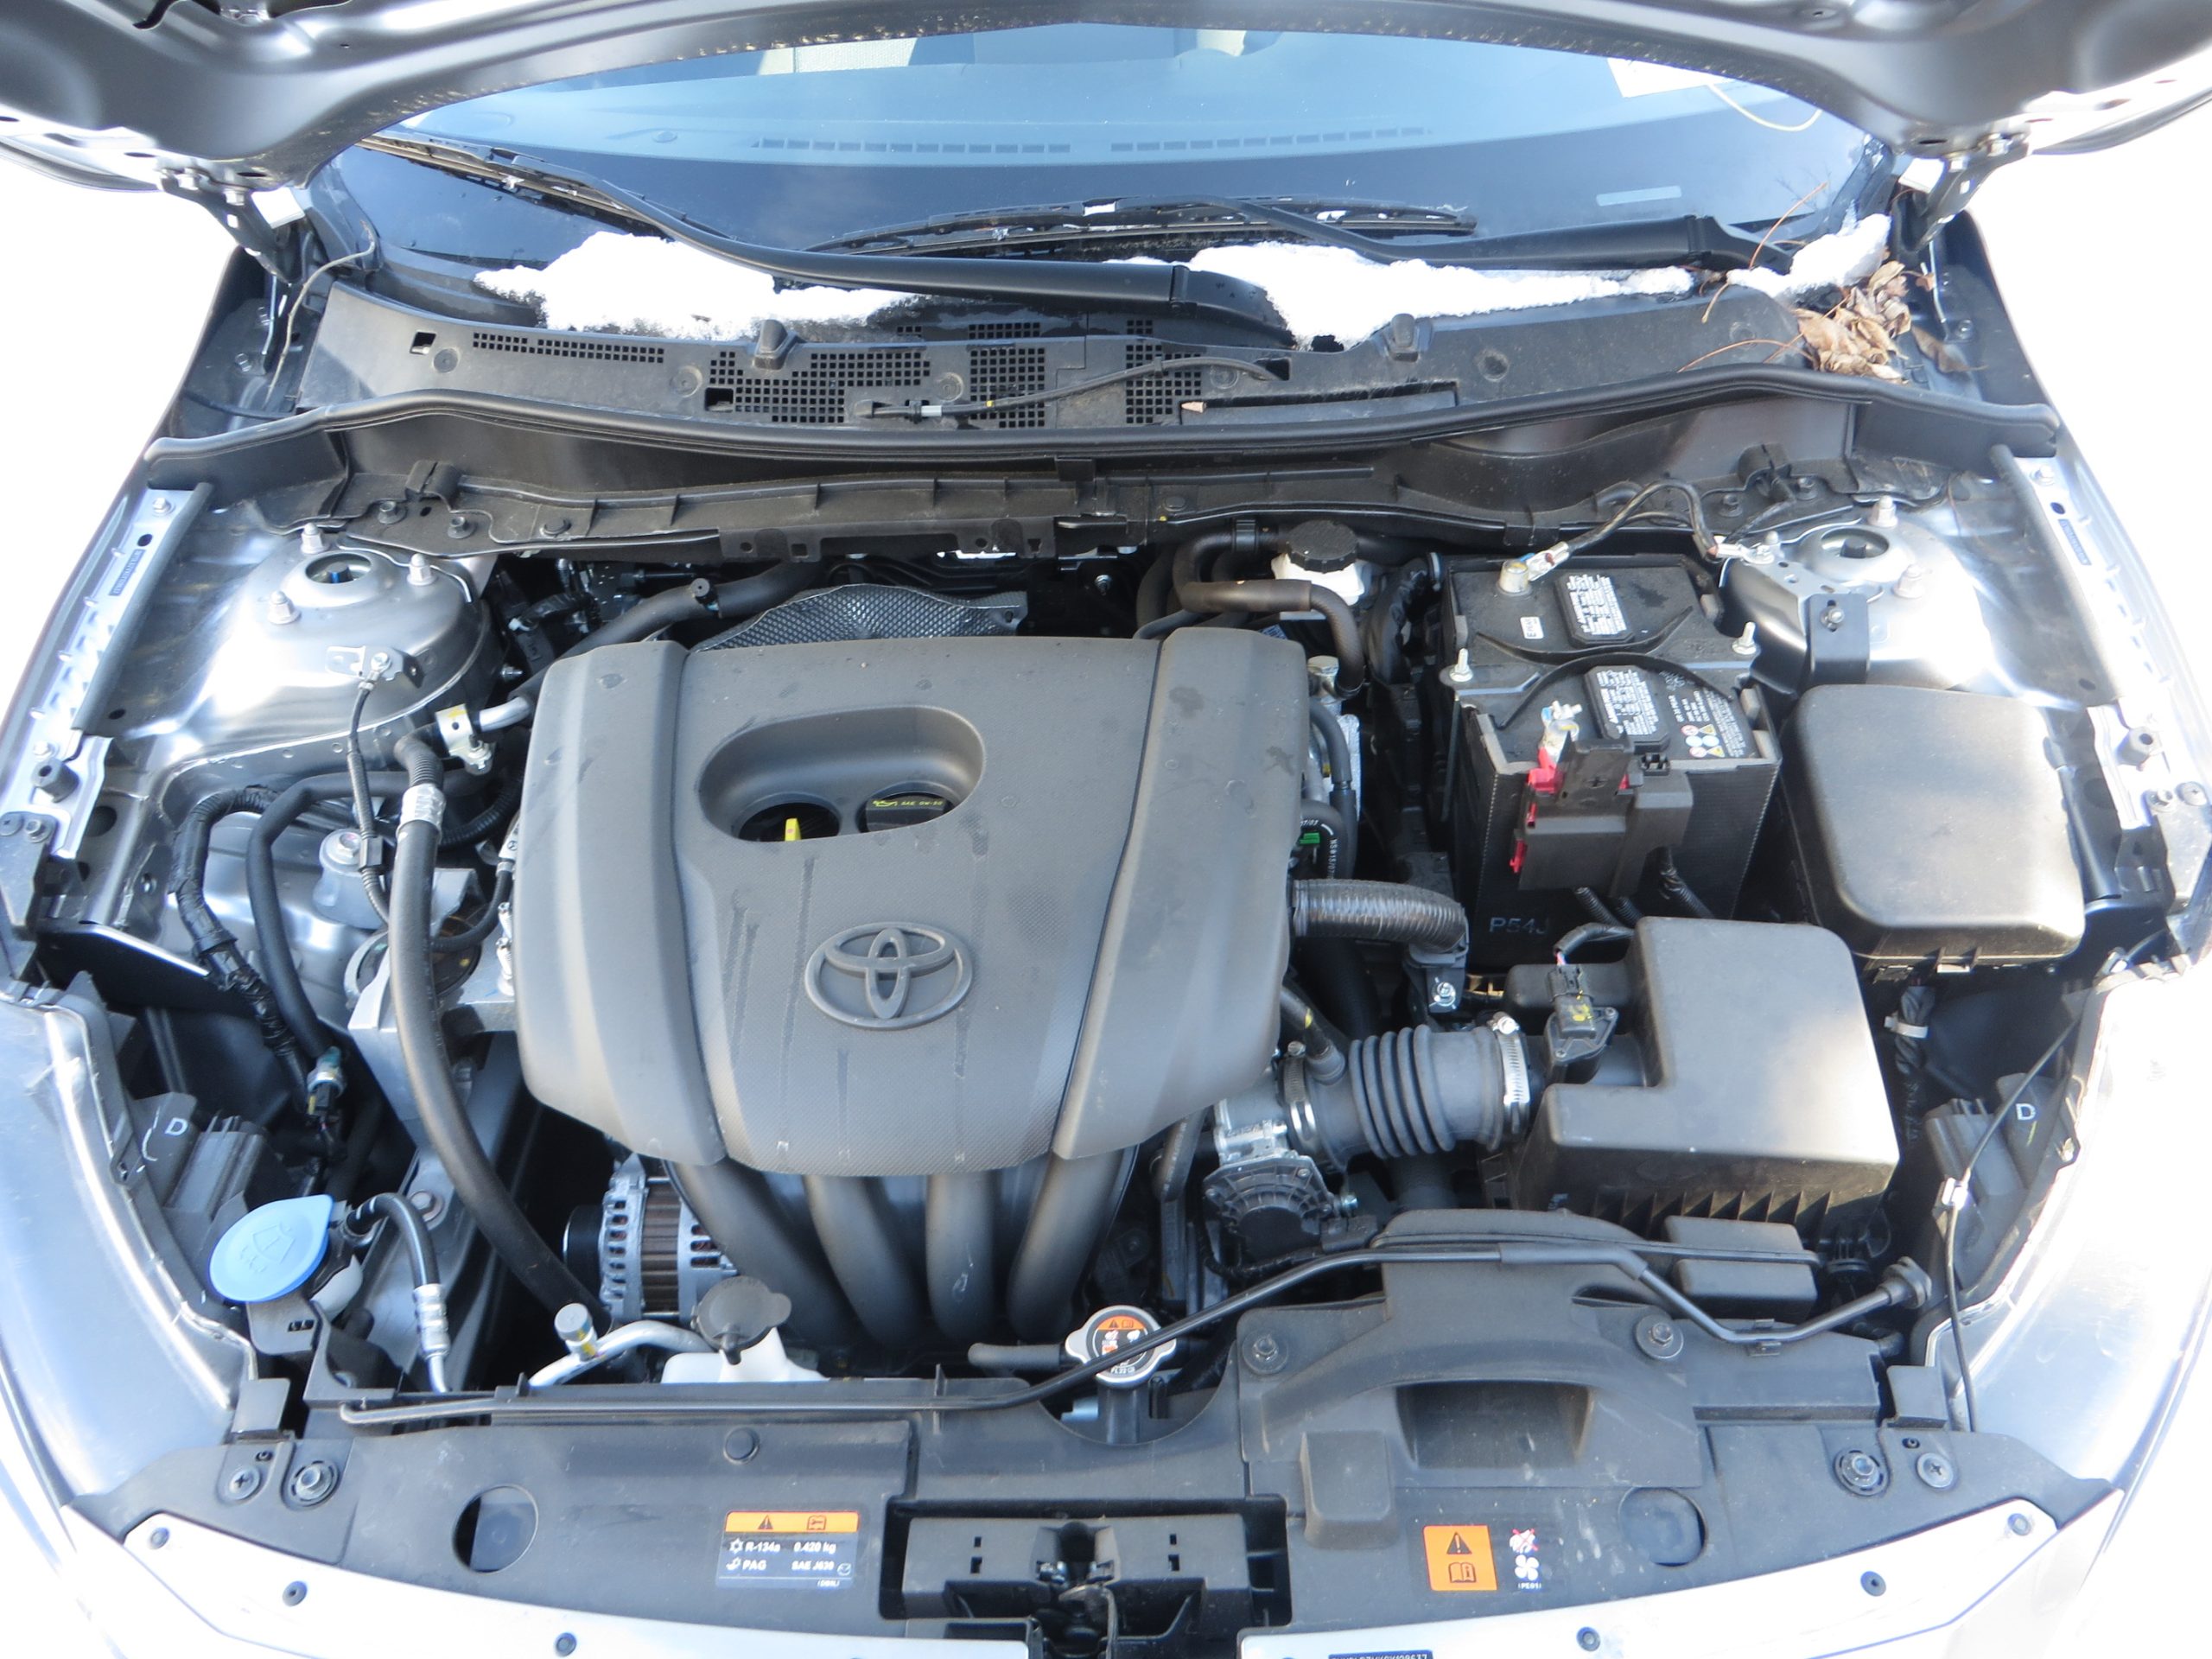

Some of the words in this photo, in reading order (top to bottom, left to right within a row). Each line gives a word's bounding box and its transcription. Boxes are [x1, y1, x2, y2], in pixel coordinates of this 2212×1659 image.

[2015, 1103, 2037, 1121] D
[164, 1117, 188, 1136] D
[745, 1541, 781, 1552] R-134a
[793, 1541, 822, 1553] 0.420
[823, 1541, 836, 1554] kg
[742, 1560, 767, 1570] PAG
[791, 1560, 812, 1570] SAE
